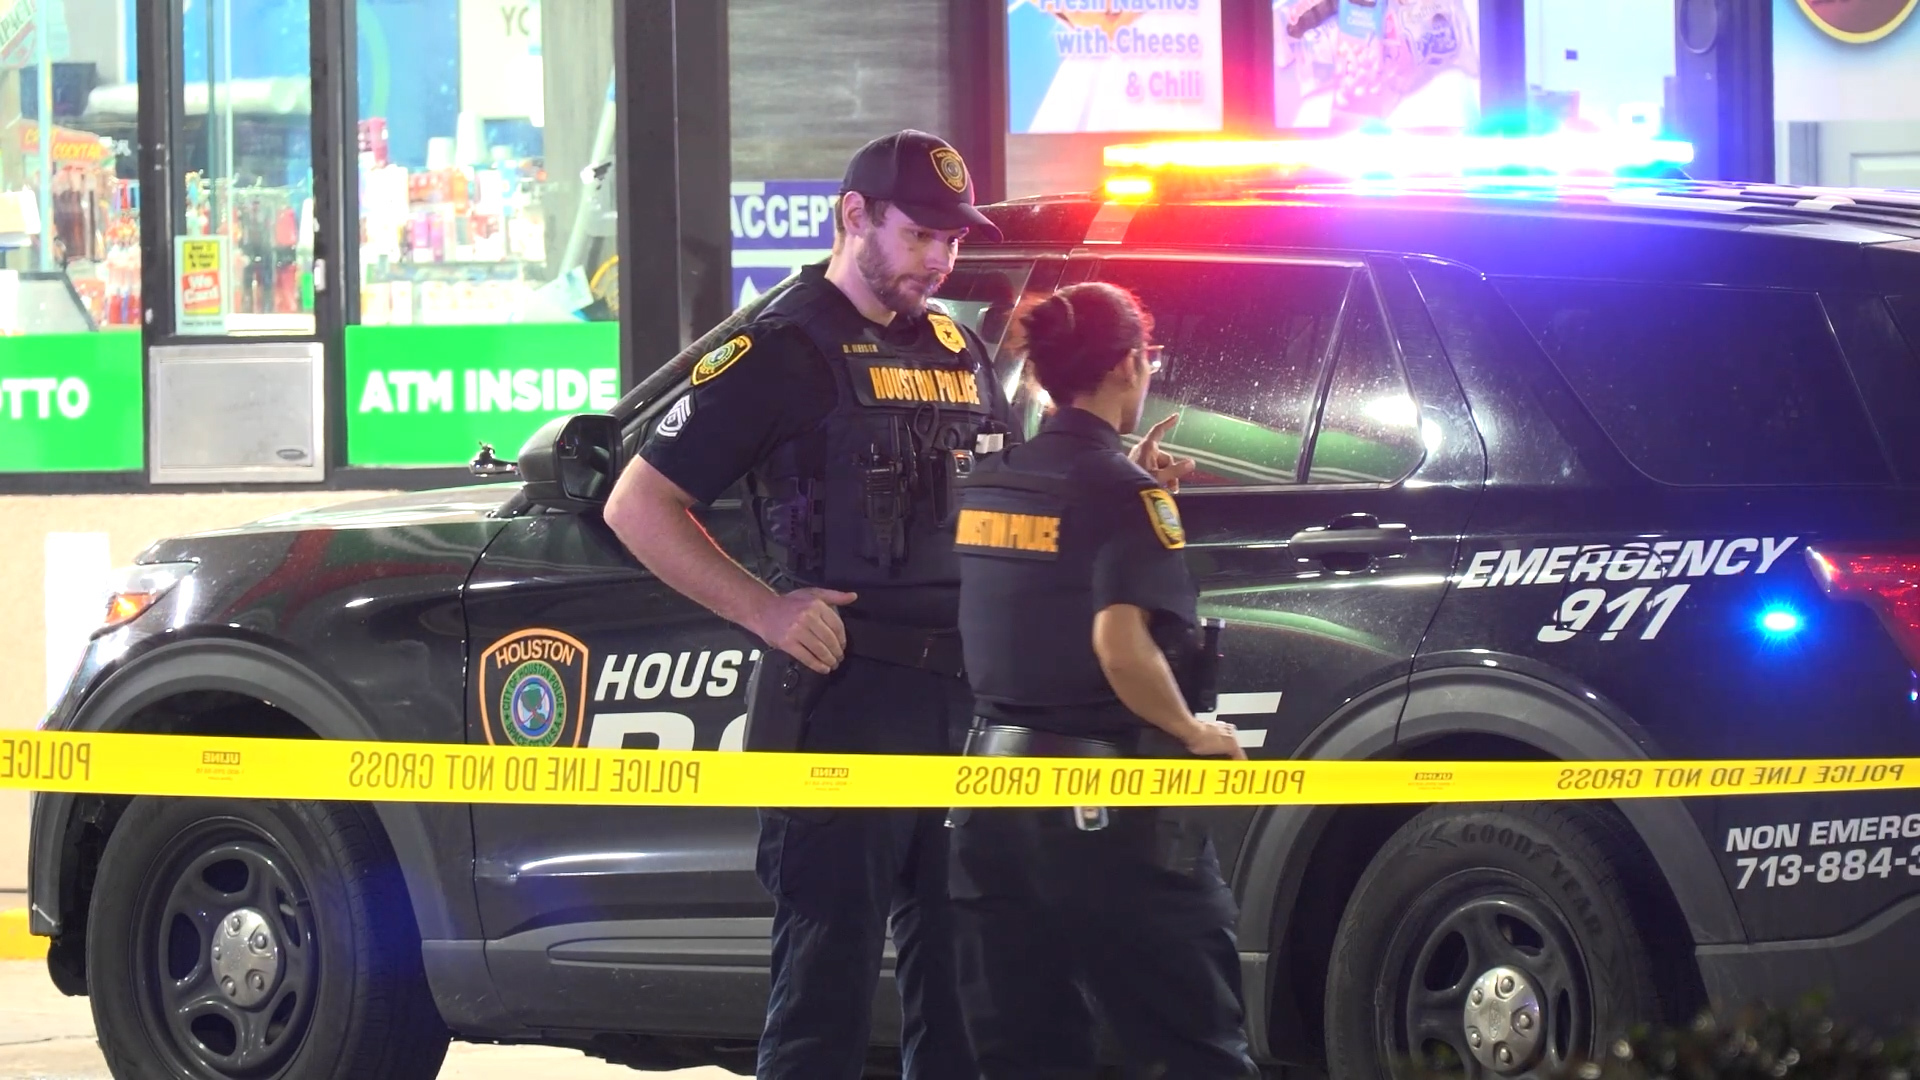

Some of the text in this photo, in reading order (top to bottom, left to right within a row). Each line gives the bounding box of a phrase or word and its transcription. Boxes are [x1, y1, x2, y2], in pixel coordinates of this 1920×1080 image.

[1057, 28, 1200, 54] with Cheese
[1126, 71, 1200, 98] & Chili
[0, 377, 91, 420] TTO
[358, 368, 617, 413] ATM INSIDE
[869, 366, 981, 405] HOUSTON POLICE
[1457, 536, 1798, 589] EMERGENCY
[1537, 584, 1691, 642] 911
[495, 640, 575, 669] HOUSTON
[594, 649, 760, 701] HOUS
[1726, 813, 1920, 852] NON EMERG
